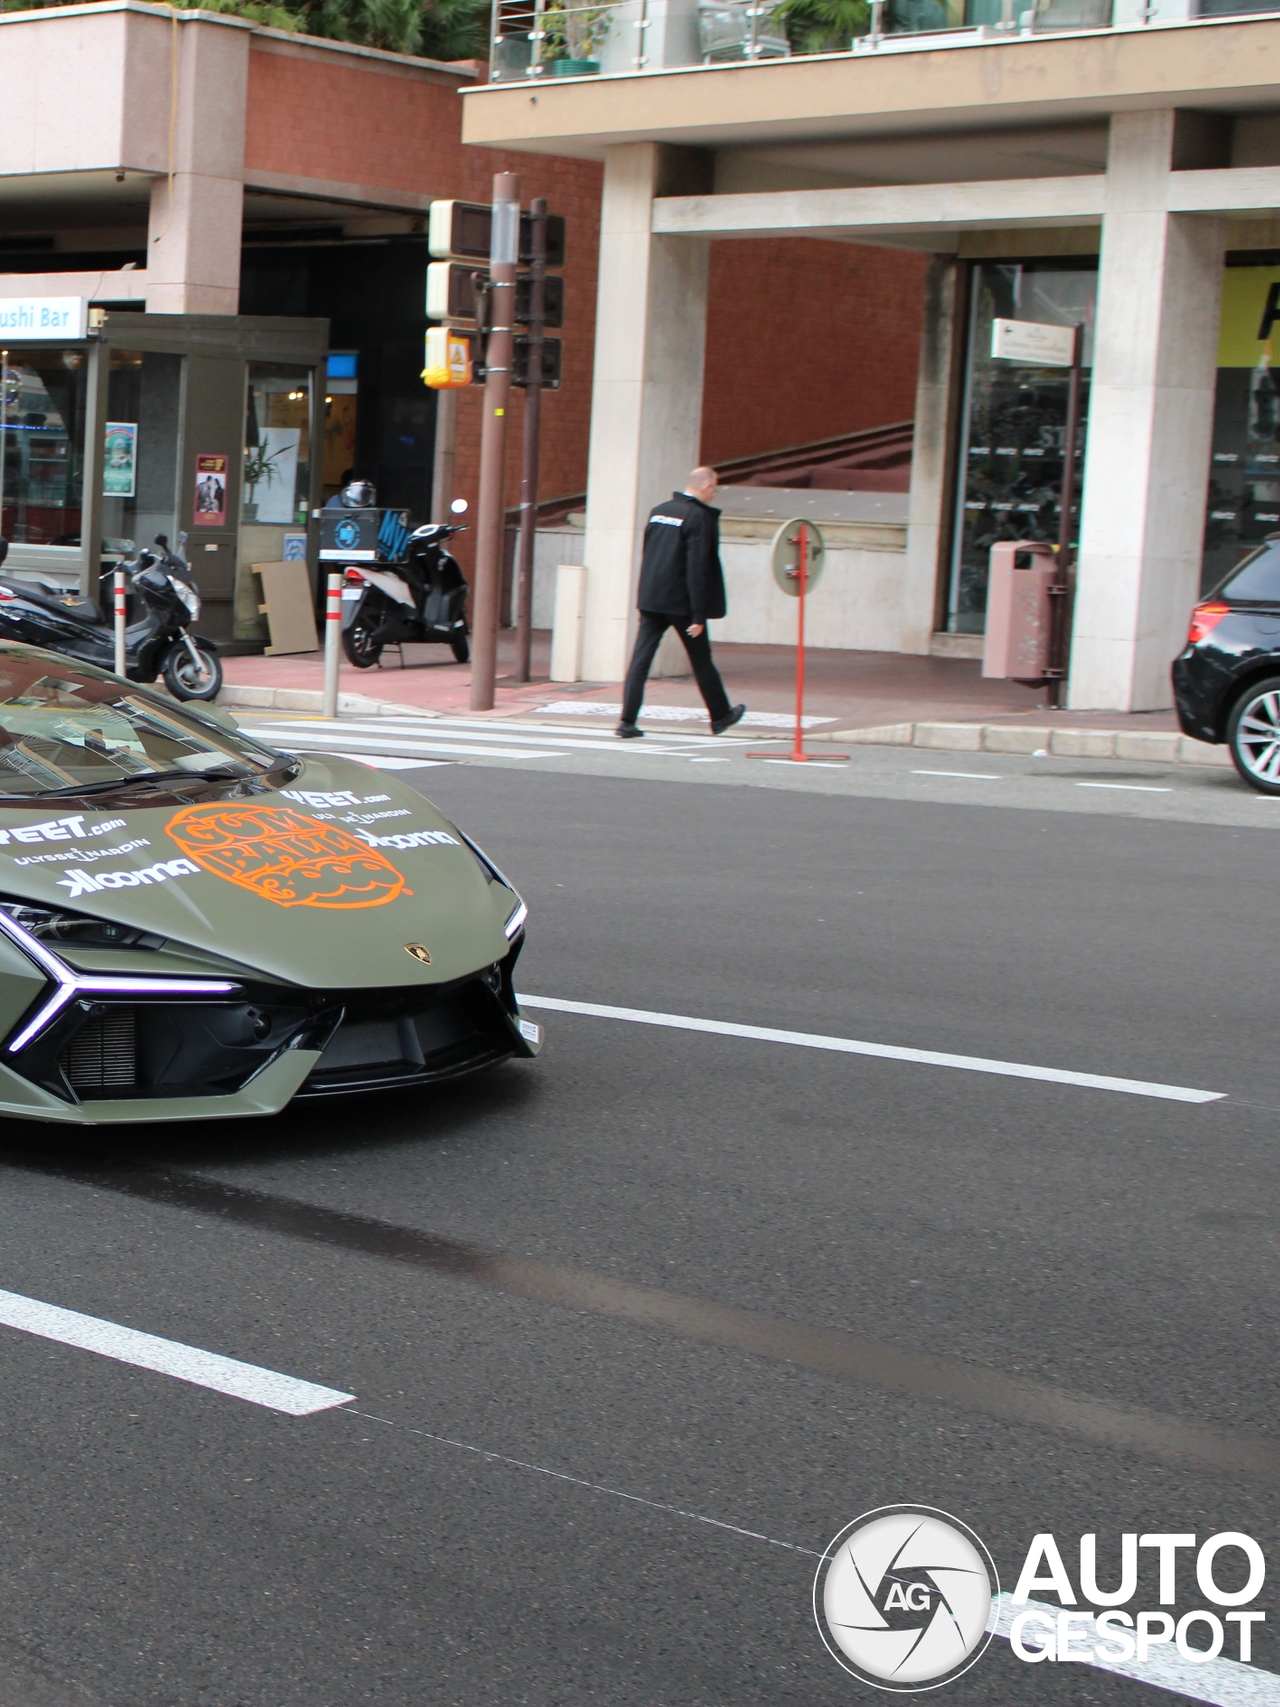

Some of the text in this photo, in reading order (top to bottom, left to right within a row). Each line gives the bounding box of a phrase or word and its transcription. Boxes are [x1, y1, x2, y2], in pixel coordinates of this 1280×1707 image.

[40, 307, 70, 327] Bar
[365, 808, 413, 822] NARDIN
[13, 838, 152, 866] ULYSSE NARDIN
